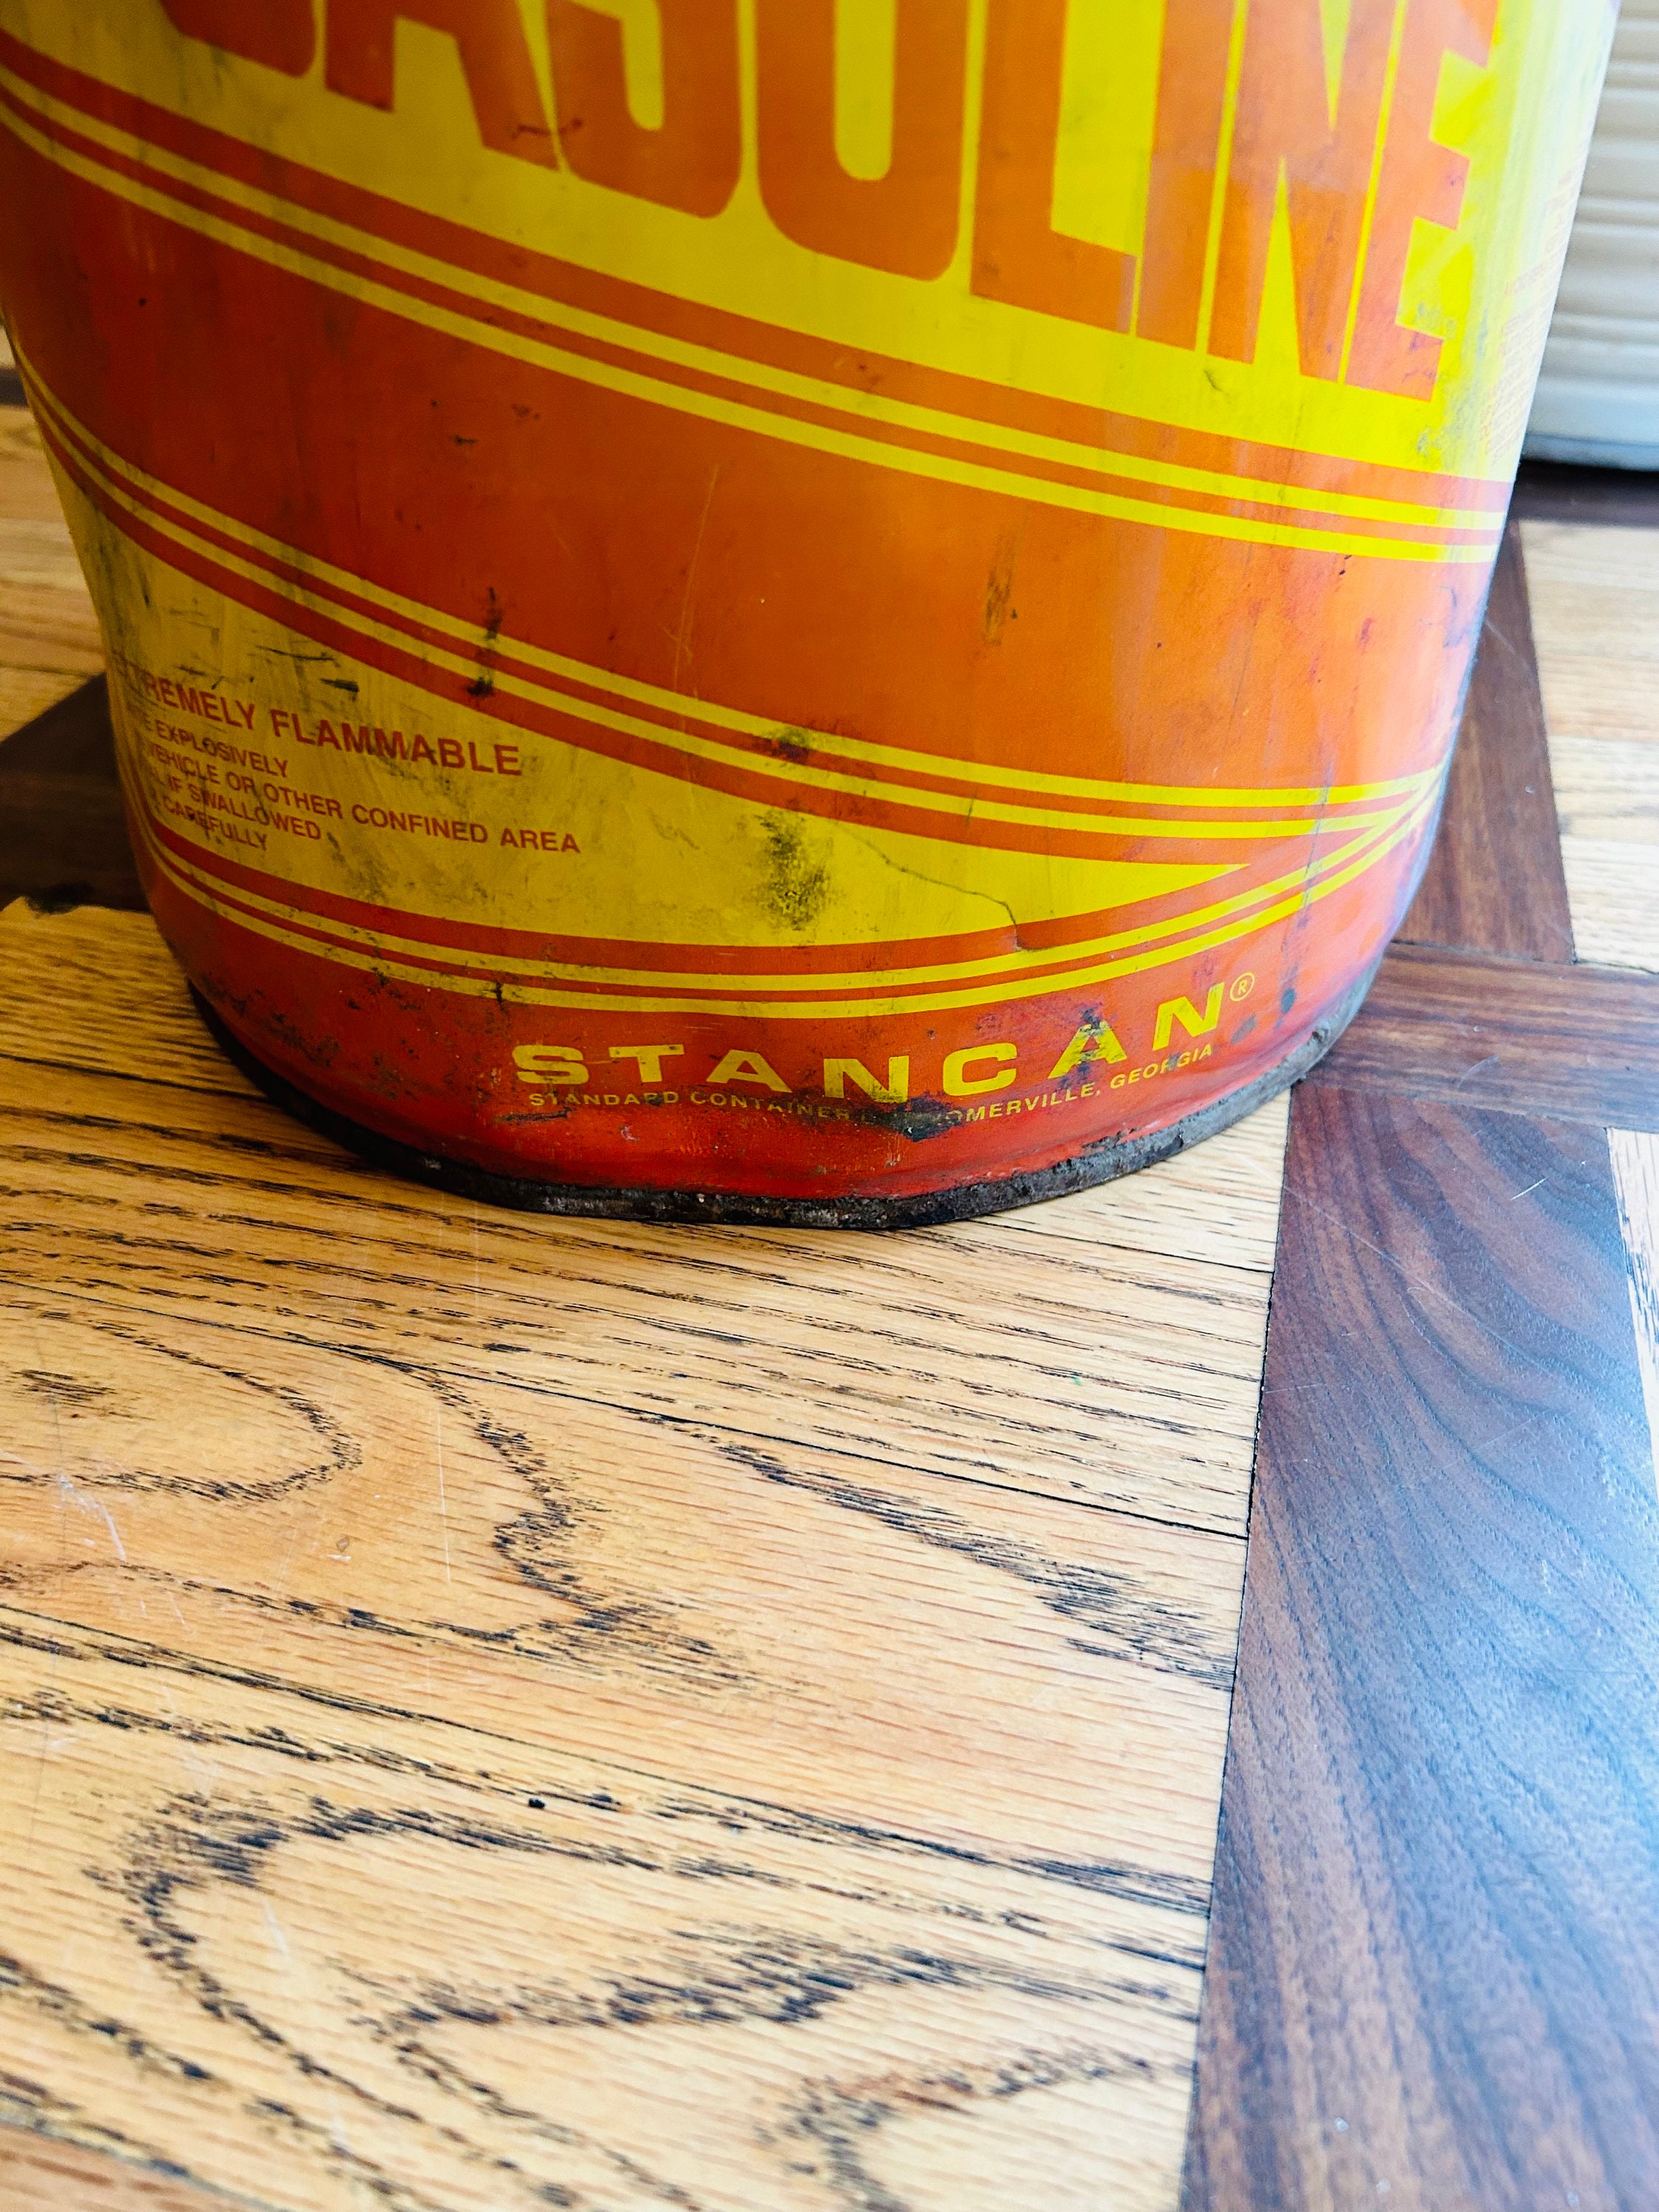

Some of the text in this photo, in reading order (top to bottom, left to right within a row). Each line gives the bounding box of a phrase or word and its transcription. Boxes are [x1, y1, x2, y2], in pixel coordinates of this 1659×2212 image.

[159, 0, 1500, 402] SOLINE
[136, 667, 523, 776] REMELY FLAMMABLE
[155, 720, 288, 777] EXPLOSIVELY
[162, 795, 267, 850] CAREFULLY
[188, 783, 321, 840] SWALLOWED
[225, 771, 256, 793] OR
[263, 782, 344, 819] OTHER
[352, 804, 488, 844] CONFINED
[501, 827, 581, 854] AREA
[529, 1091, 678, 1107] STANDARD
[690, 1091, 849, 1120] CONTAINER
[935, 1081, 1102, 1124] OMERVILLE,
[1110, 1043, 1213, 1089] GEORGIA
